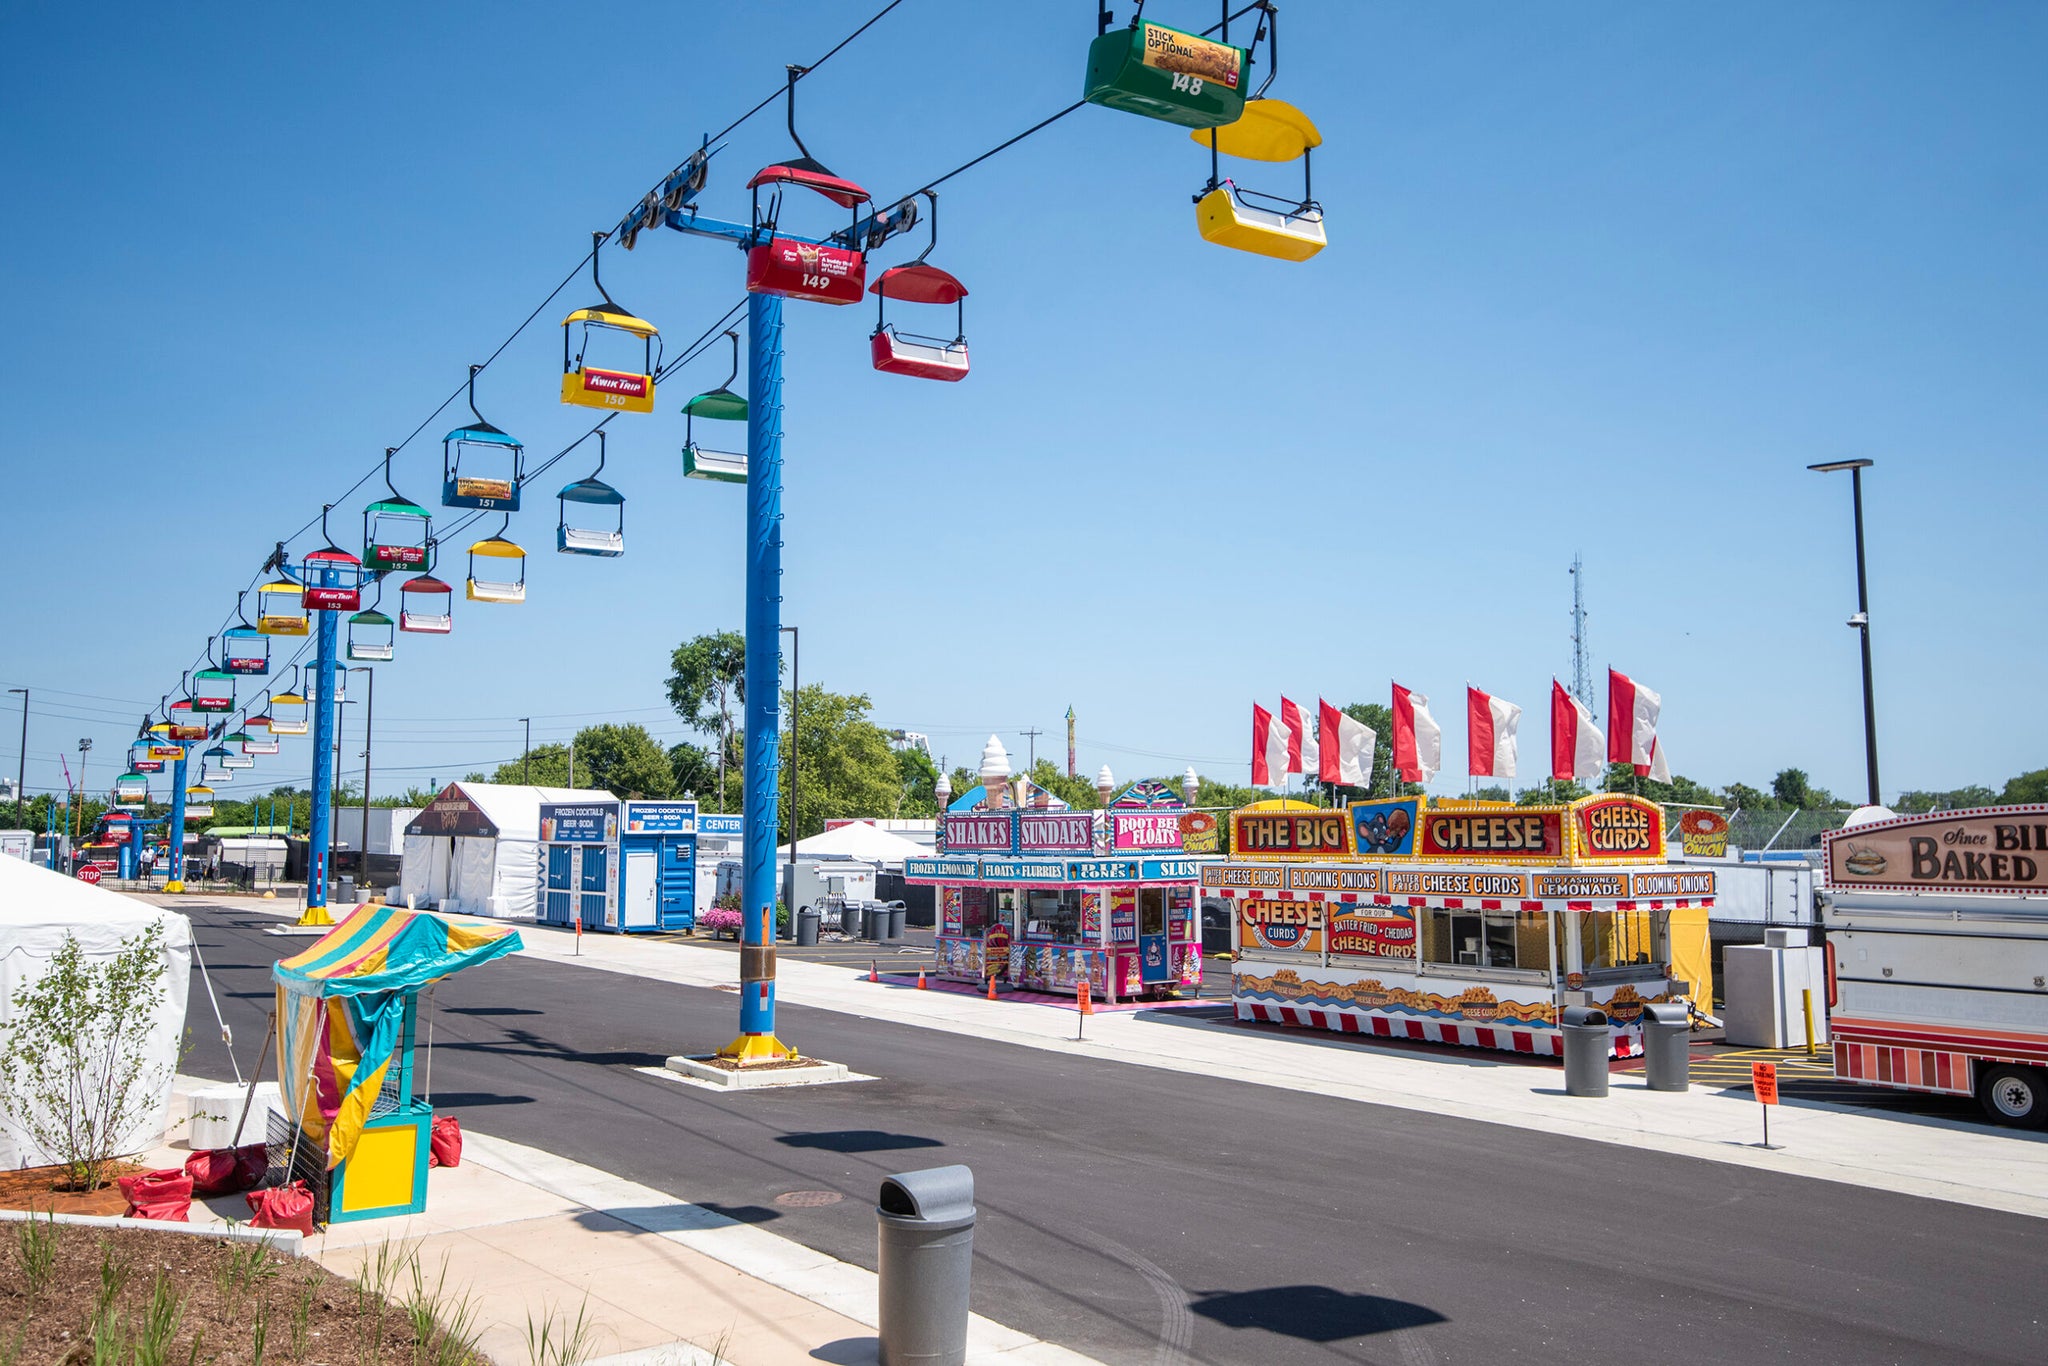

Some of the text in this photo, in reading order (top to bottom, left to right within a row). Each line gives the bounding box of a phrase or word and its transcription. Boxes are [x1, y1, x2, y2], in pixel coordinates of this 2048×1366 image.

[1148, 28, 1174, 43] STICK
[1148, 38, 1193, 58] OPTIONAL
[1171, 72, 1203, 96] 148
[802, 273, 830, 289] 149
[604, 394, 626, 406] 150
[479, 498, 495, 508] 151
[392, 562, 408, 570] 152
[554, 808, 604, 817] FROZEN COCKTAILS
[1590, 805, 1649, 828] CHEESE
[563, 820, 594, 828] BEER SODA
[705, 819, 740, 830] CENTER
[1118, 817, 1180, 835] ROOT BEE
[947, 821, 1087, 845] SHAKES SUNDAES
[1132, 829, 1176, 845] FLOATS
[1242, 818, 1341, 849] THE BIG
[1431, 817, 1546, 852] CHEESE
[1591, 828, 1650, 851] CURDS
[1943, 827, 1987, 845] Since
[1184, 837, 1217, 851] ONION
[1684, 841, 1727, 857] ONION
[1909, 837, 2038, 881] BAKED
[79, 871, 100, 880] STOP
[910, 862, 976, 876] FROZEN LEMONADE
[985, 865, 1061, 878] FLOATS FLURRIES
[1081, 870, 1126, 878] CONES
[1223, 869, 1280, 886] CHEESE CURDS
[1293, 871, 1376, 889] BLOOMING ONIONS
[1392, 873, 1419, 883] BATTER
[1422, 875, 1521, 895] CHEESE CURDS
[1543, 876, 1618, 885] OLD FASHIONED
[1637, 875, 1709, 894] BLOOMING ONIONS
[1392, 882, 1420, 891] FRIED
[1539, 883, 1623, 896] LEMONADE
[1241, 899, 1321, 929] CHEESE
[1361, 908, 1372, 916] FOR
[1268, 927, 1296, 939] CURDS
[1333, 919, 1413, 940] BATTER FRIED CHEDDAR
[1331, 936, 1416, 958] CHEESE CURDS
[1481, 1007, 1498, 1017] CURD
